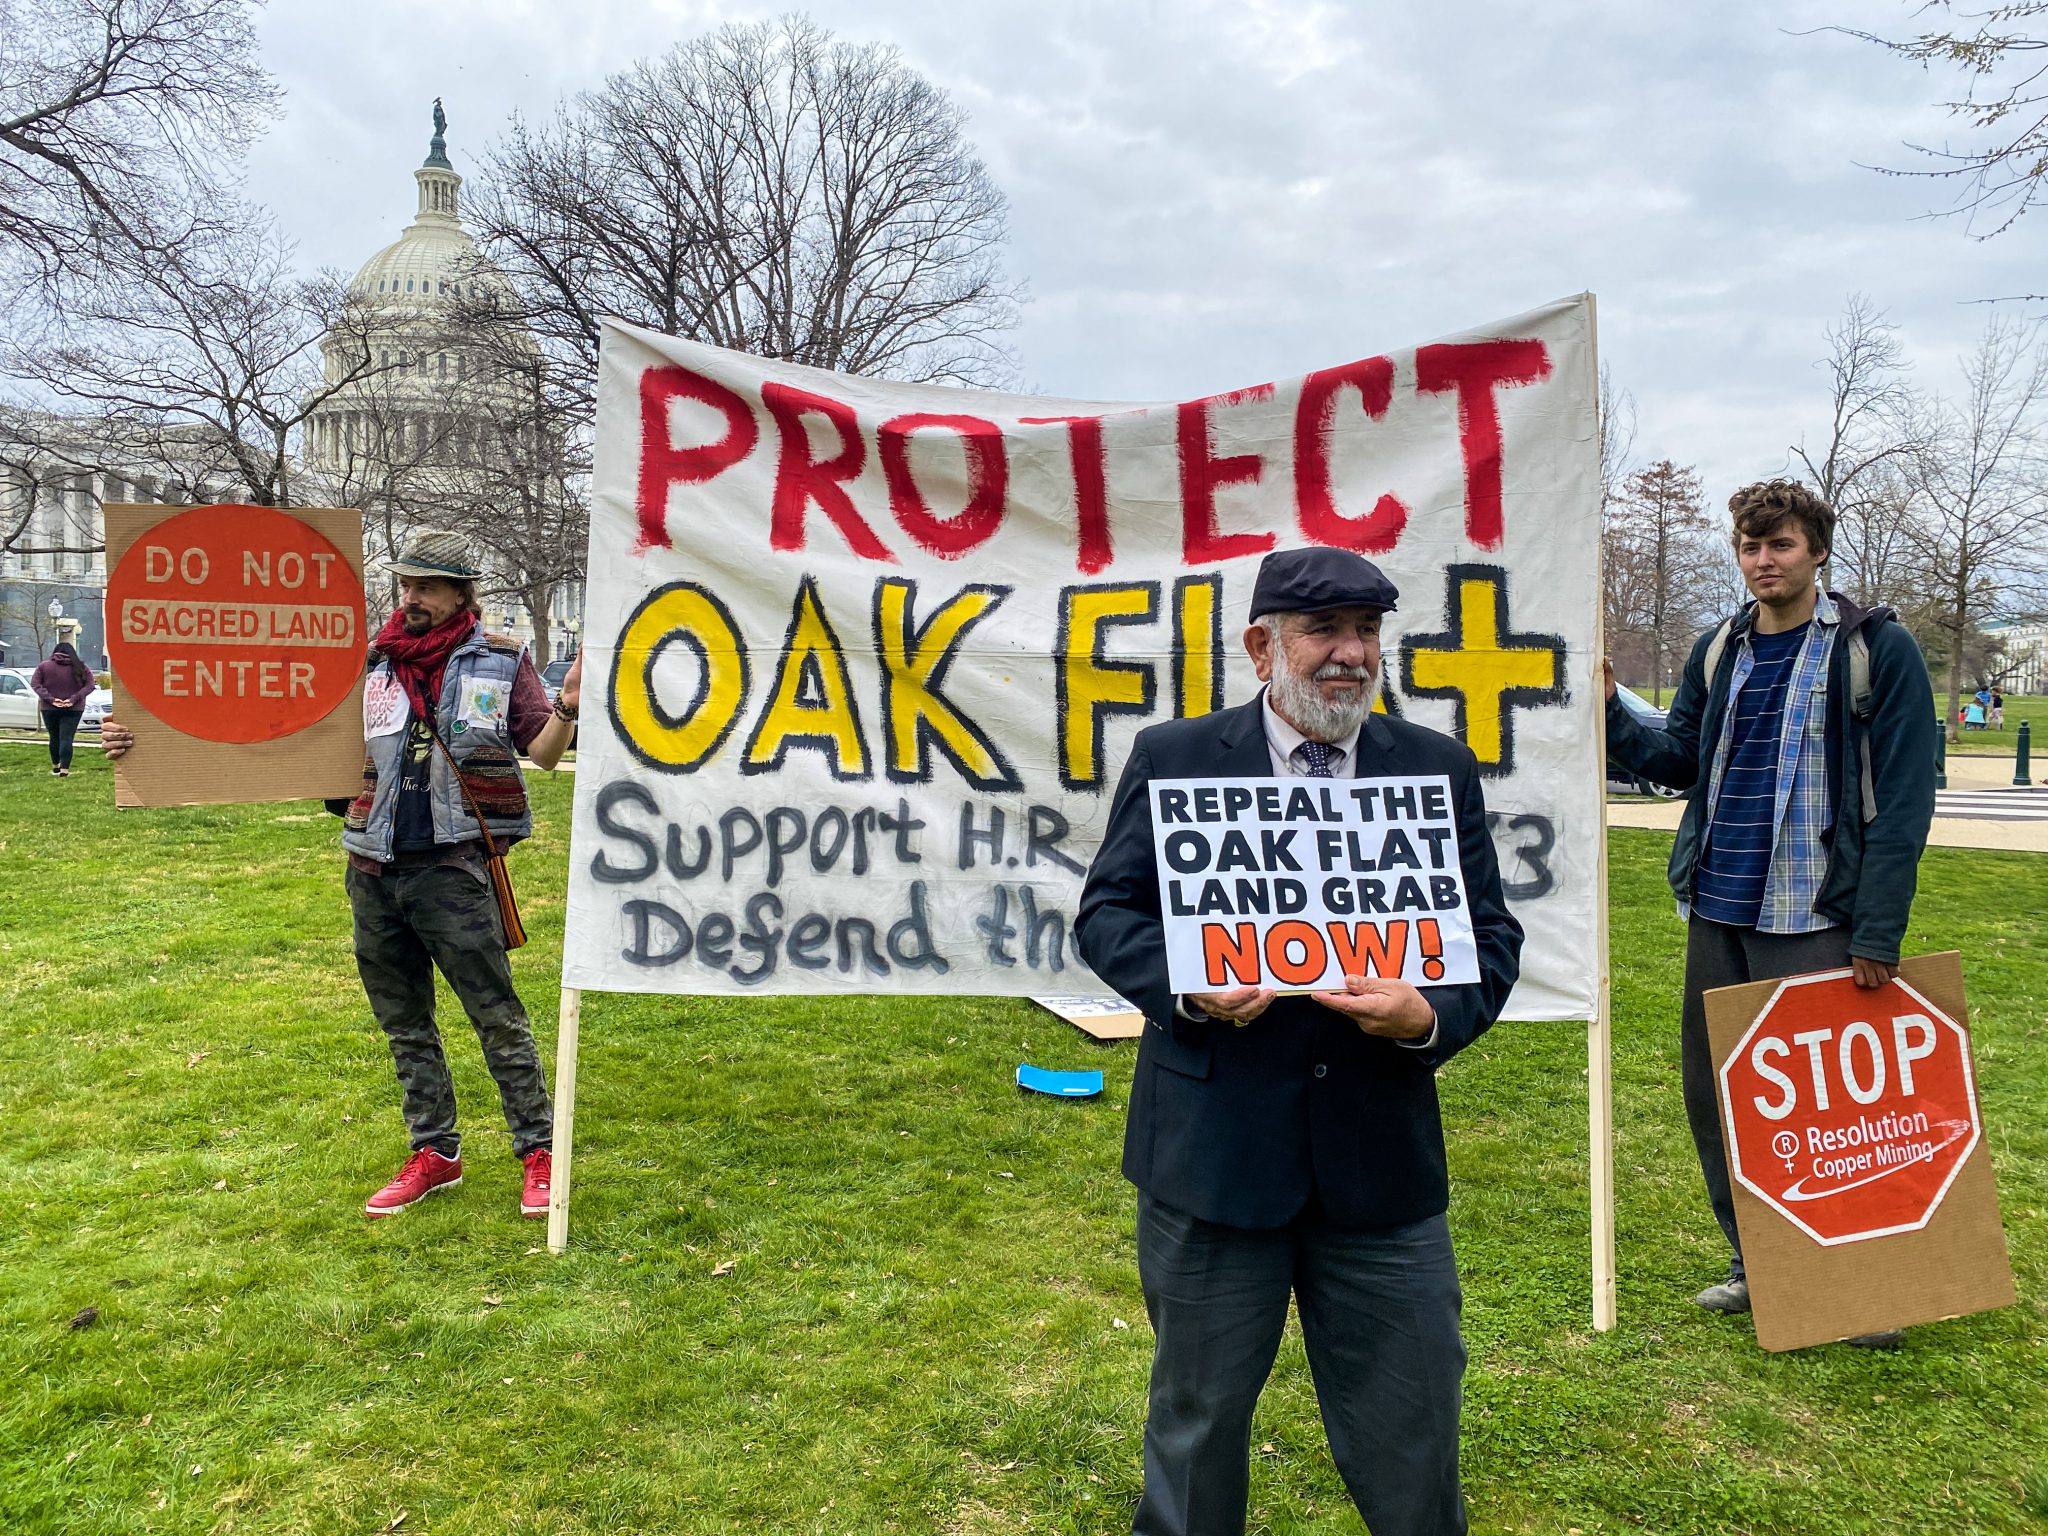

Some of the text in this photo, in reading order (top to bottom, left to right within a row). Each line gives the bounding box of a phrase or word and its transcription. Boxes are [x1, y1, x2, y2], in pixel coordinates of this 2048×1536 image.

[632, 337, 1553, 576] PROTECT
[145, 546, 336, 589] DO NOT
[129, 605, 349, 640] SACRED LAND
[163, 659, 316, 698] ENTER
[607, 573, 1025, 793] OAK
[402, 776, 418, 790] The
[1159, 785, 1449, 823] REPEAL THE
[590, 780, 925, 888] Support
[1165, 829, 1303, 874] OAK
[1316, 828, 1451, 872] FLAT
[1169, 876, 1460, 916] LAND GRAB
[622, 879, 1089, 985] Defend th
[1201, 918, 1446, 986] NOW!
[1752, 1013, 1937, 1120] STOP
[1806, 1111, 1929, 1154] Resolution
[1813, 1140, 1934, 1180] Copper Mining
